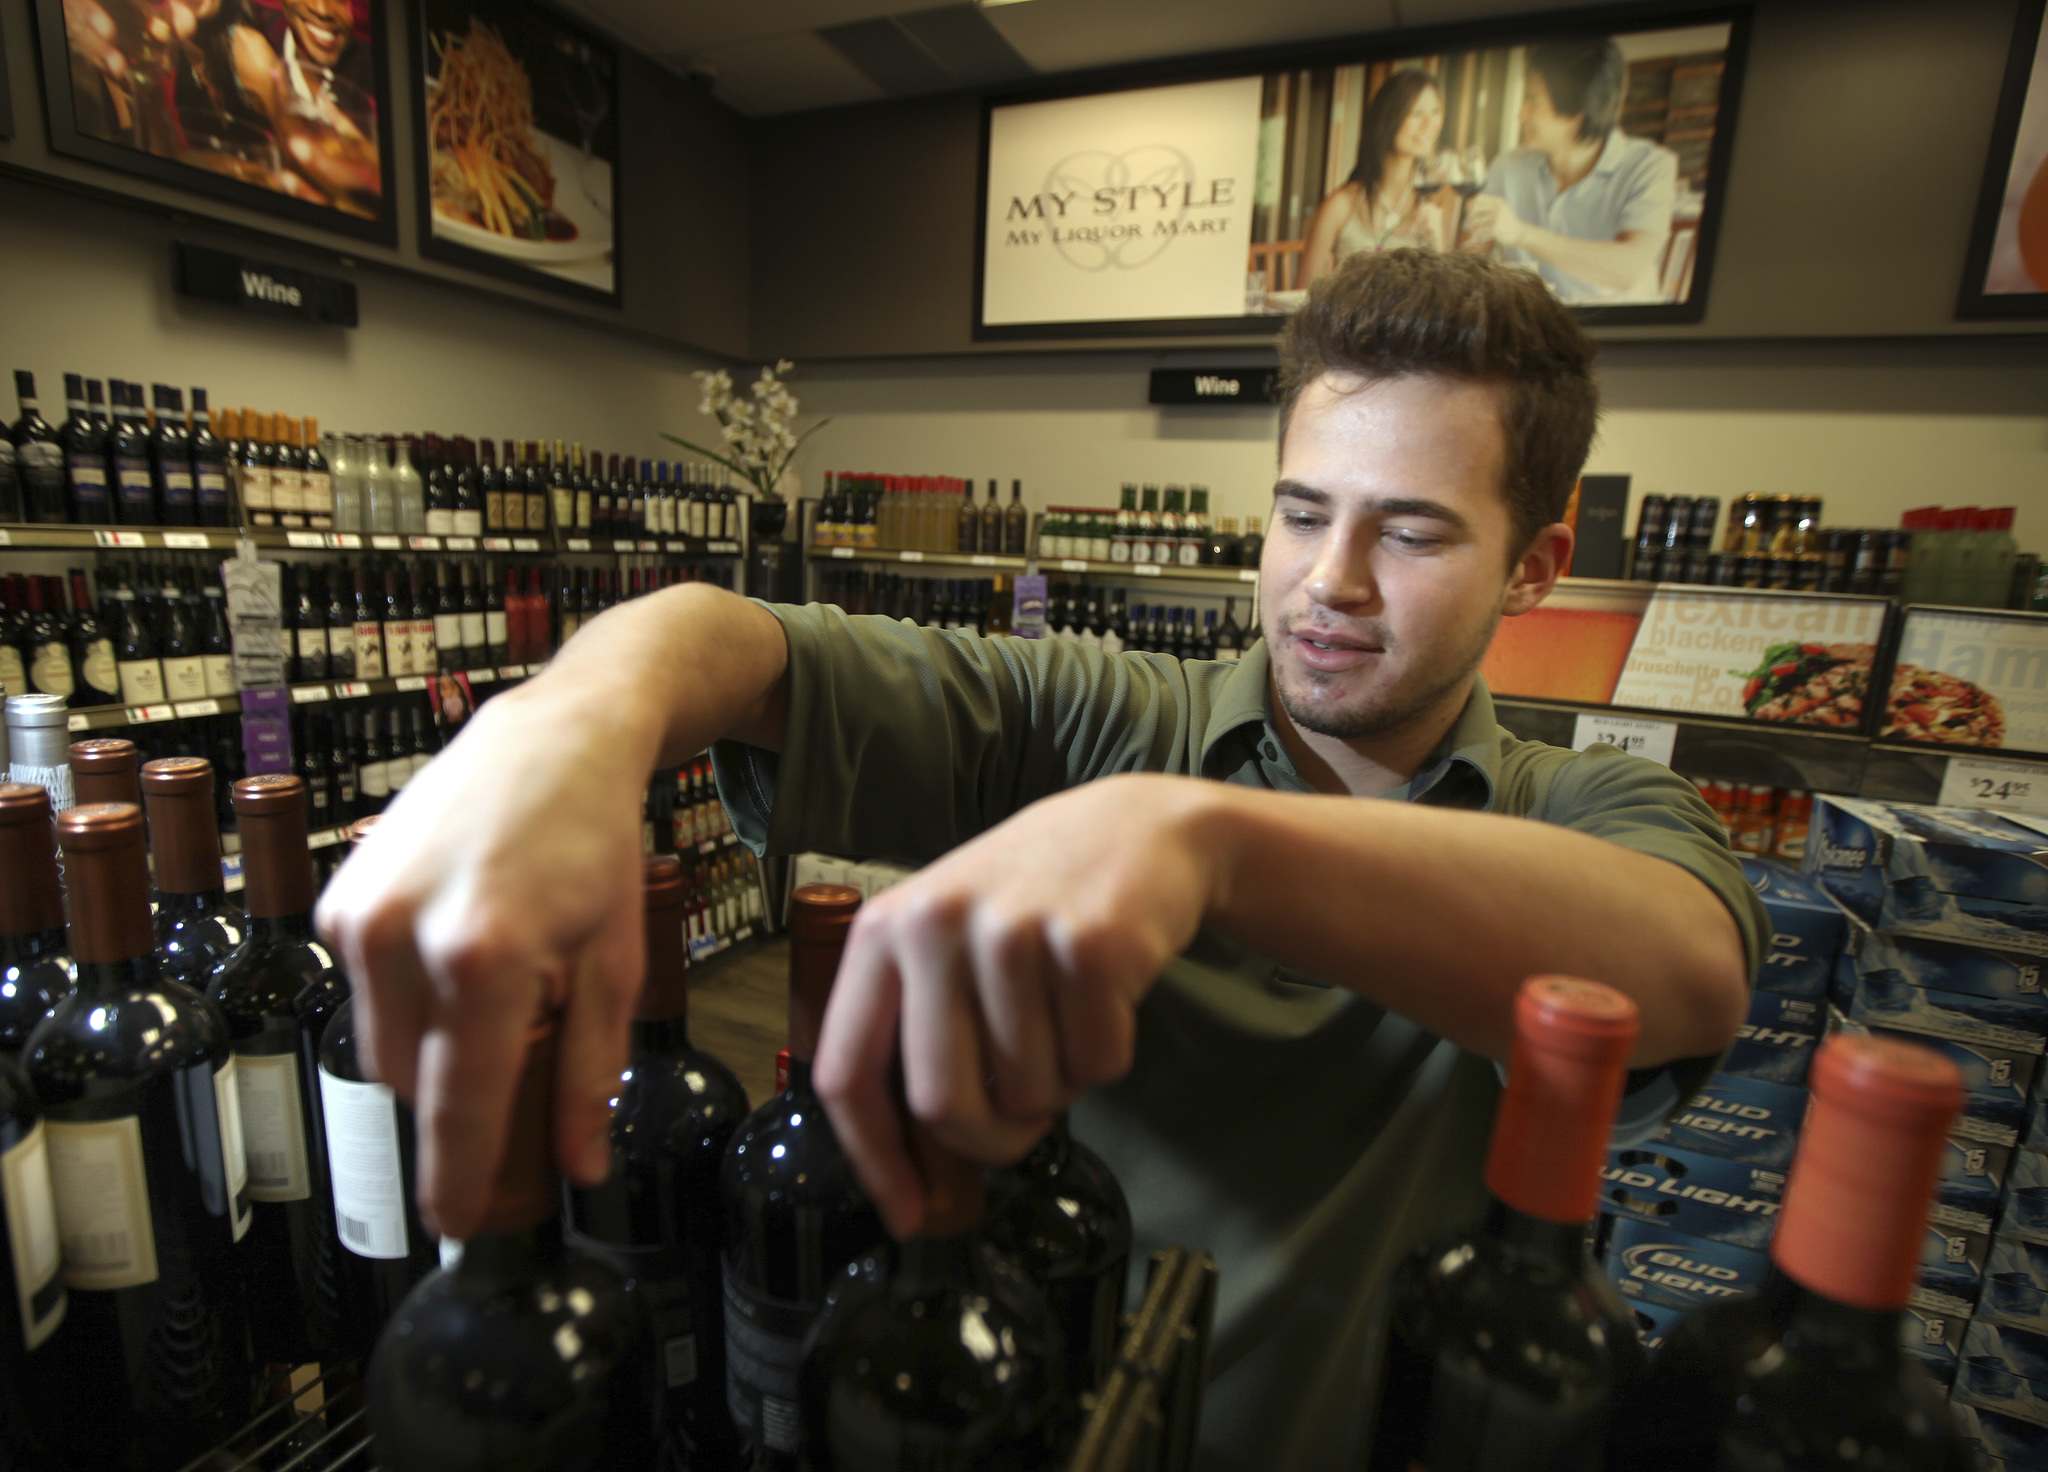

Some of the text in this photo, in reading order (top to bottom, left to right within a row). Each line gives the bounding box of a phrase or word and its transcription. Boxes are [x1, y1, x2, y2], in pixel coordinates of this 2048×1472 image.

[1005, 177, 1236, 222] MY STYLE
[241, 270, 302, 307] Wine
[1194, 375, 1241, 396] Wine
[1649, 622, 1785, 654] blacken
[1670, 1112, 1777, 1141] IGHT
[1598, 1165, 1783, 1217] UD LIGHT
[1629, 1264, 1746, 1298] LIGHT
[1649, 1251, 1740, 1281] BUD
